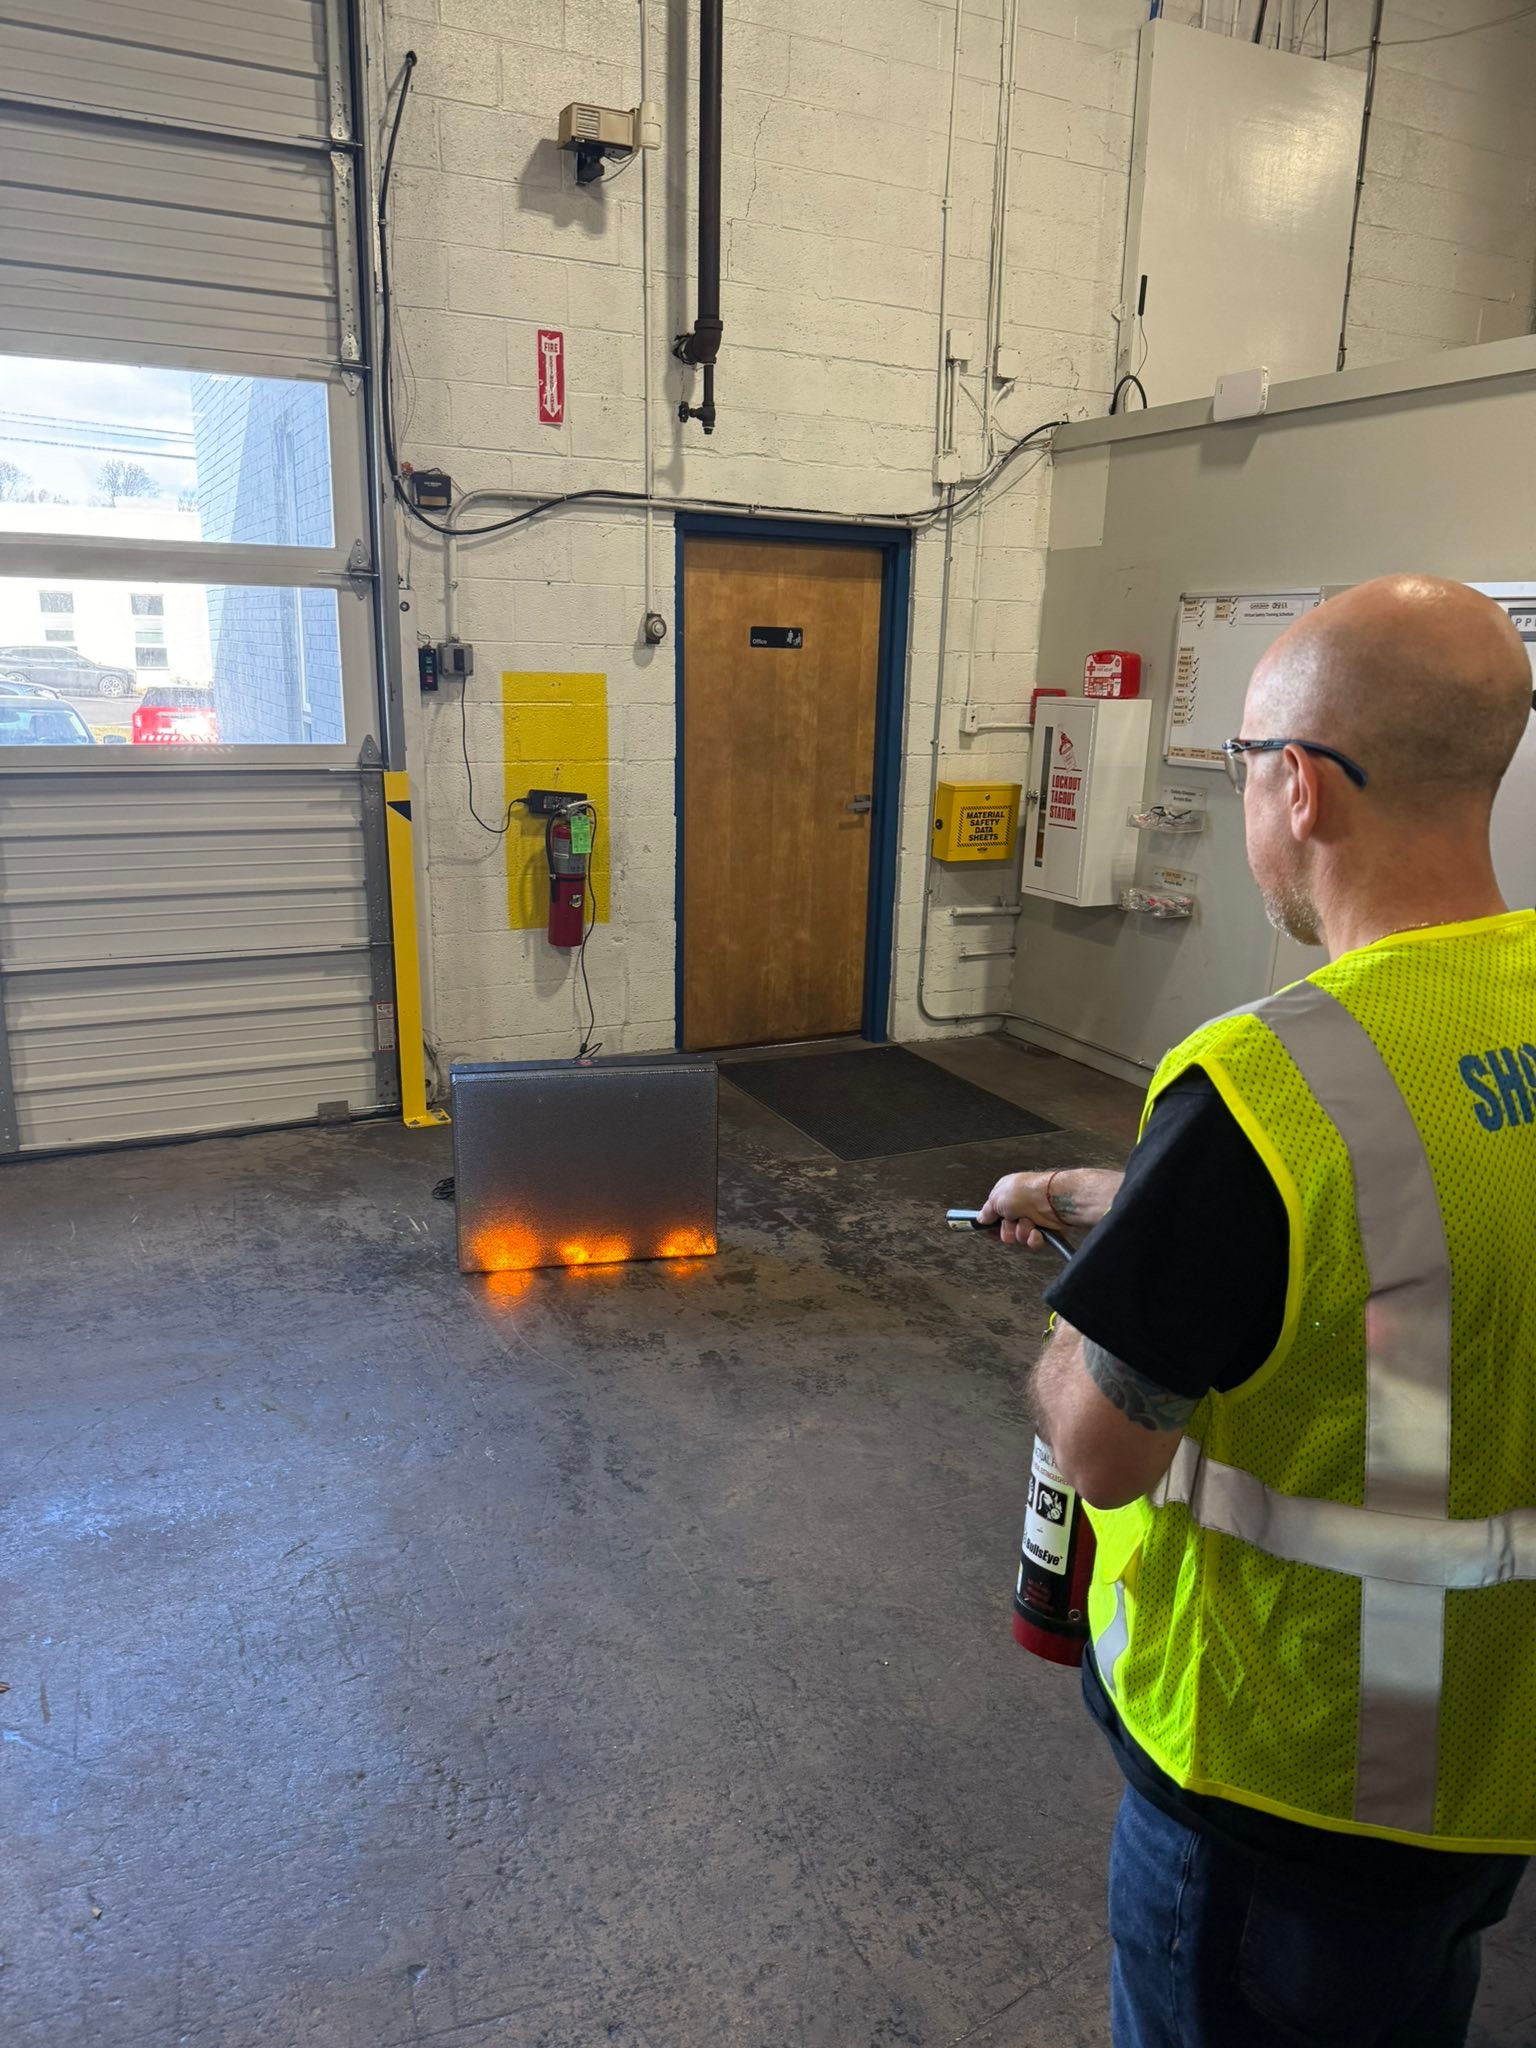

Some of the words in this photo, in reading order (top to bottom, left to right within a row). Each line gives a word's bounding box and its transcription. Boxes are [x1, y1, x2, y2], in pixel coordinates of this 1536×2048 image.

[543, 342, 558, 353] FIRE
[1515, 617, 1536, 627] PP
[1052, 774, 1081, 791] LOCKOUT
[1051, 789, 1076, 806] TAGOUT
[966, 811, 1005, 819] MATERIAL
[1049, 805, 1076, 822] STATION
[970, 819, 1000, 827] SAFETY
[975, 826, 994, 834] DATA
[968, 834, 999, 842] SHEETS
[1034, 1447, 1051, 1466] CTUAL
